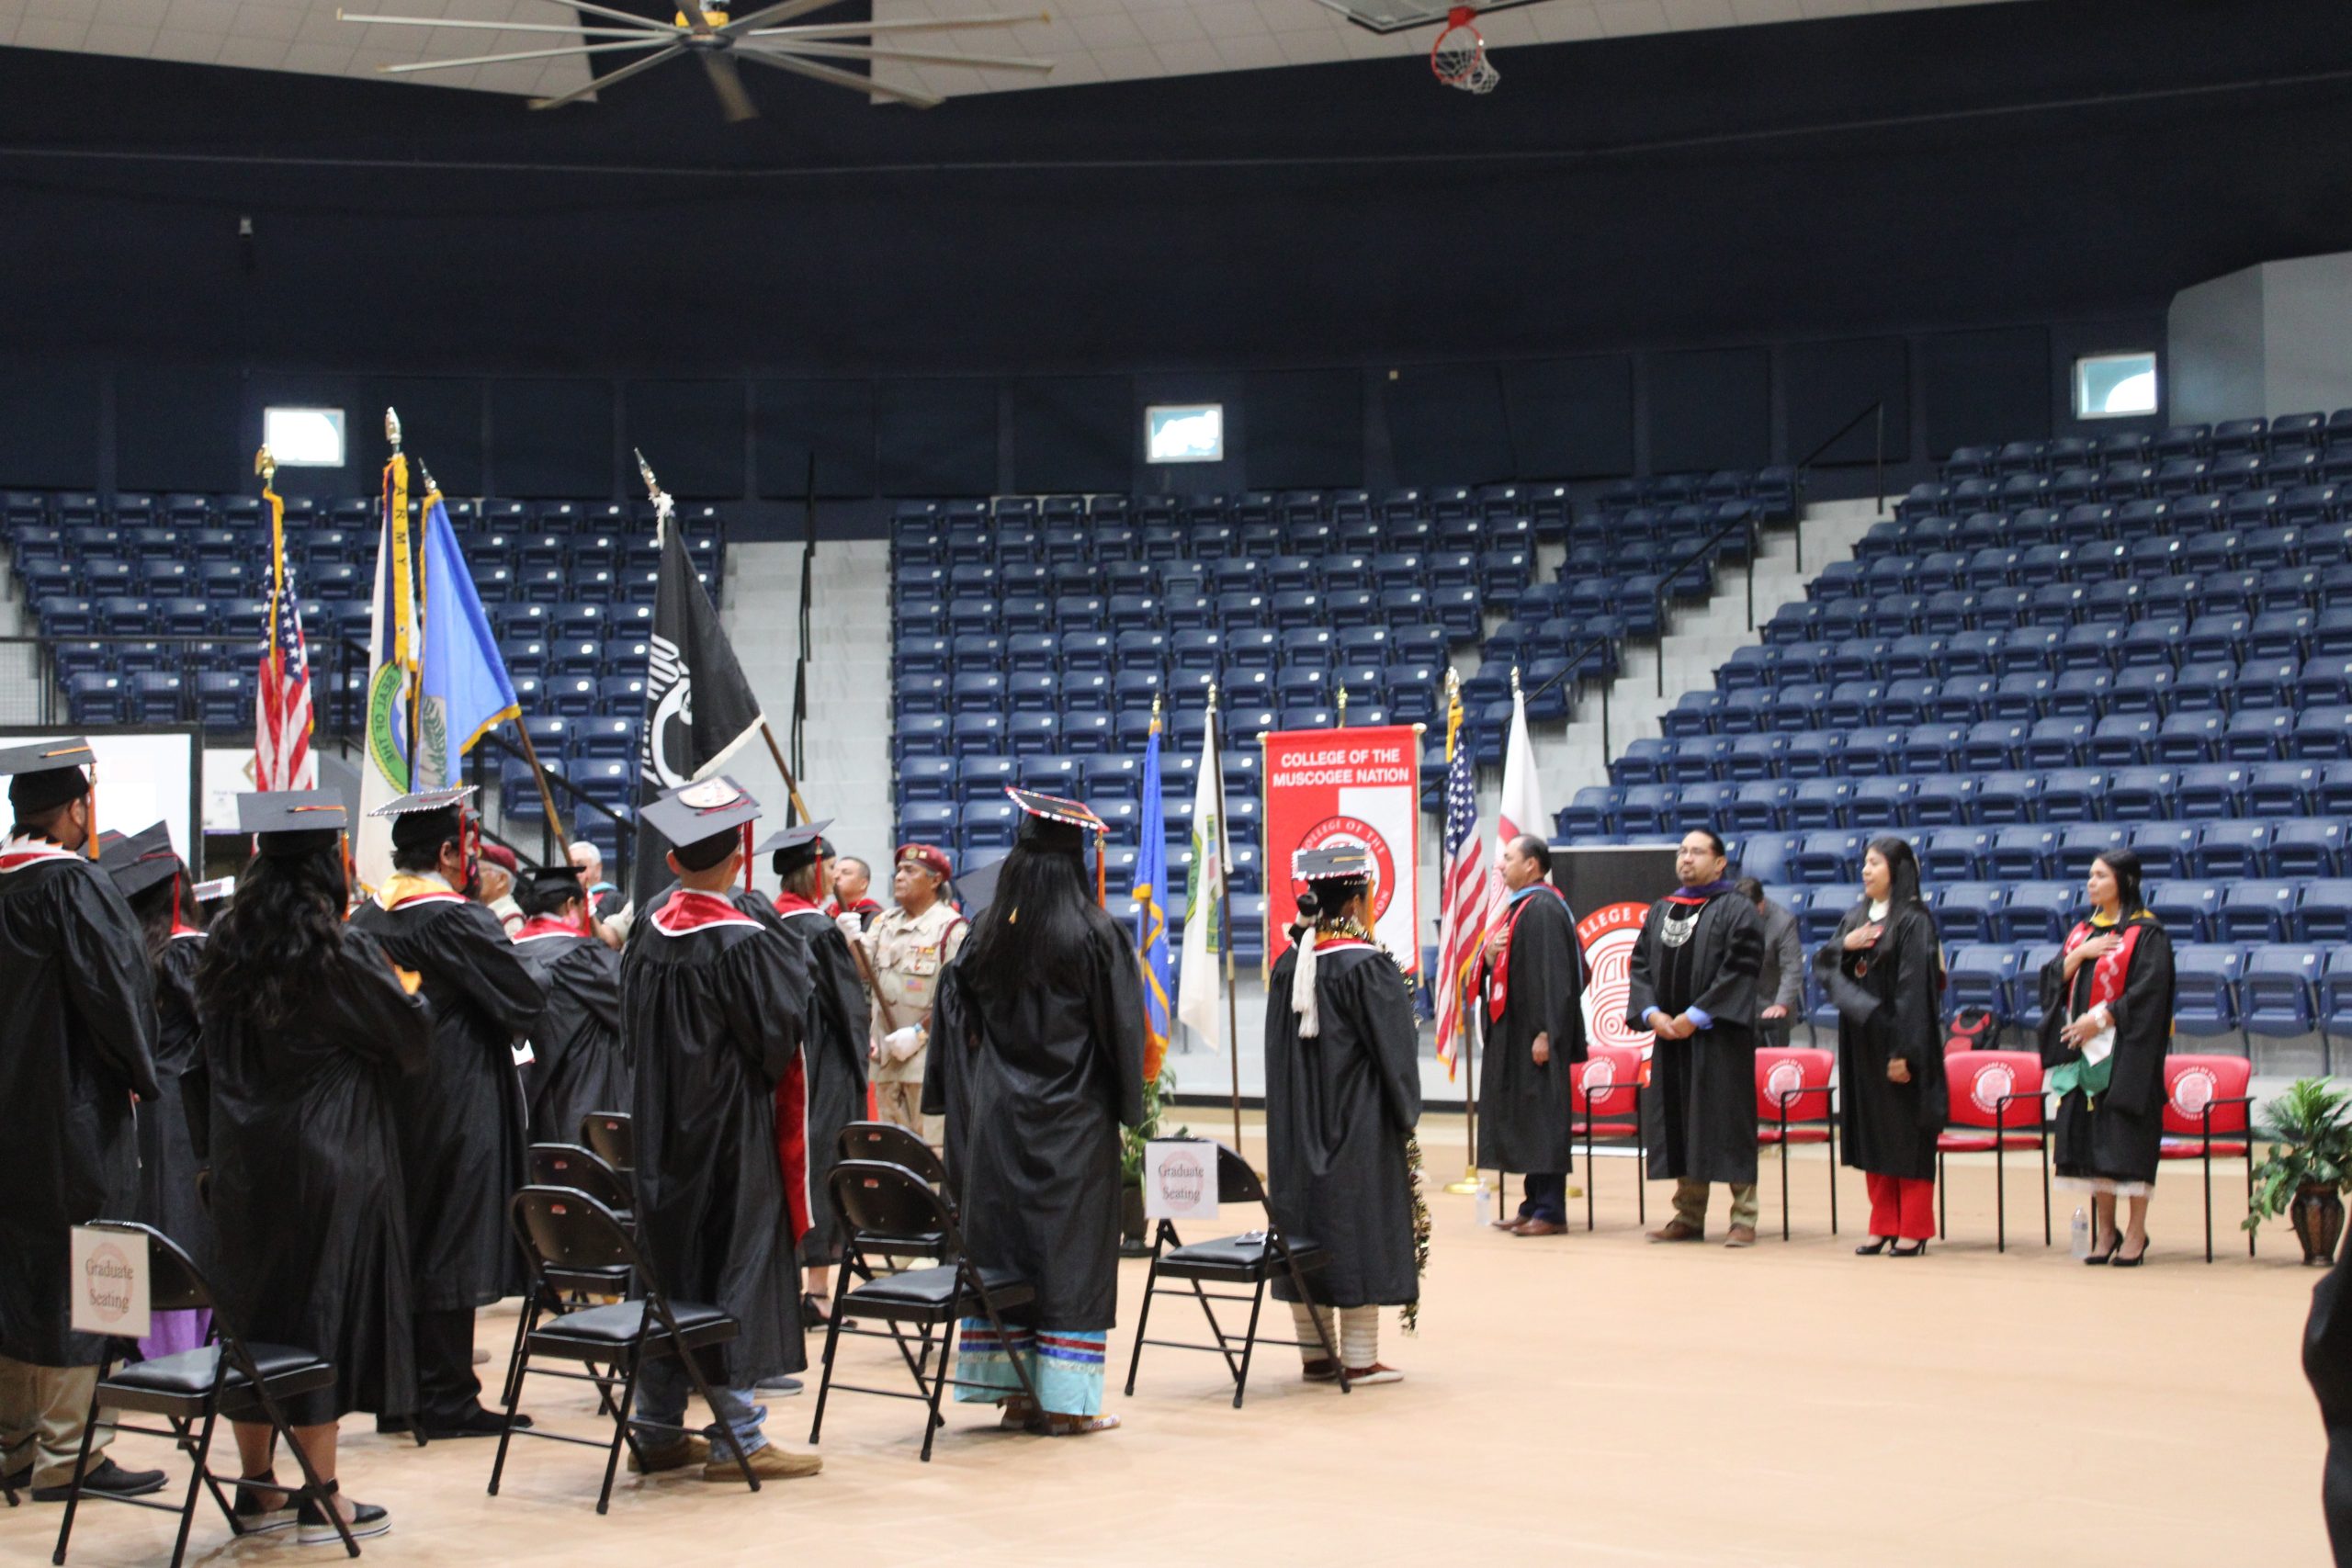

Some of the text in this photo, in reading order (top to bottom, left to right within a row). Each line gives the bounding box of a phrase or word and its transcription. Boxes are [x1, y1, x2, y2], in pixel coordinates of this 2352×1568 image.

[396, 485, 407, 567] ARMY
[1281, 748, 1400, 768] COLLEGE OF THE
[1272, 767, 1408, 787] MUSCOGEE NATION
[1305, 820, 1341, 848] OLLEGE
[1579, 907, 1632, 940] LLEGE
[1159, 1163, 1204, 1178] Graduate
[1162, 1186, 1201, 1205] Seating
[85, 1258, 133, 1280] Graduate
[89, 1288, 130, 1314] Seating
